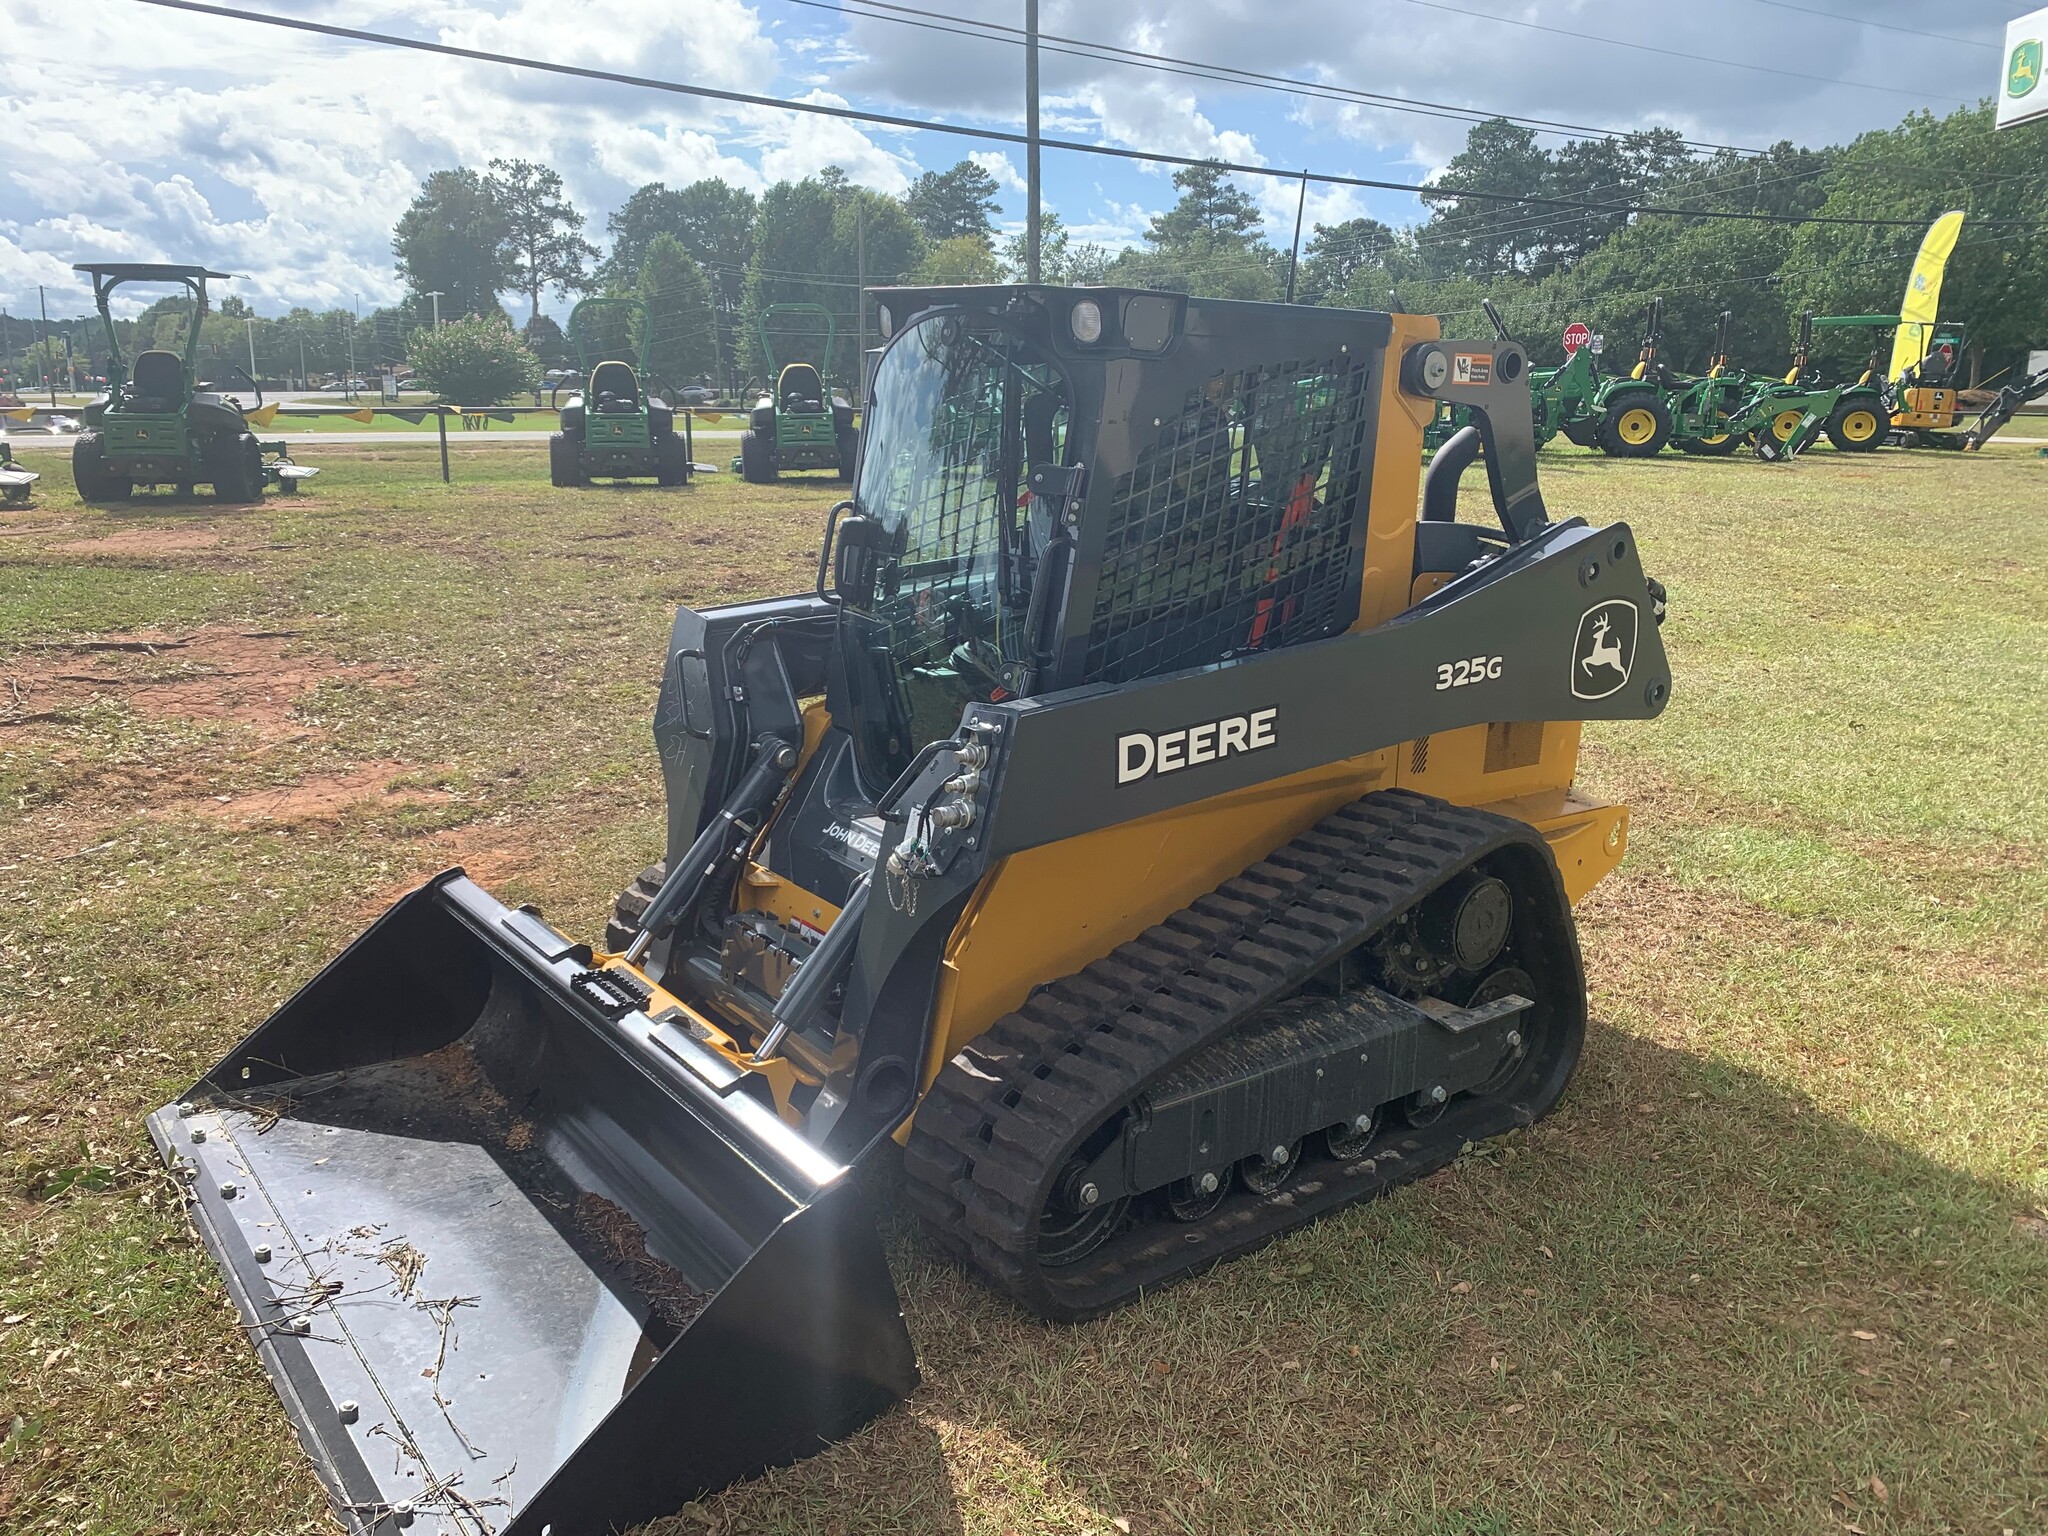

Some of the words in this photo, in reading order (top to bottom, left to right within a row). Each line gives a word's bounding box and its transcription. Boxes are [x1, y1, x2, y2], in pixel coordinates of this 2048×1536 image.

[1565, 333, 1587, 345] STOP
[1435, 656, 1503, 691] 325G
[1118, 708, 1277, 784] DEERE
[822, 821, 856, 847] JOHN
